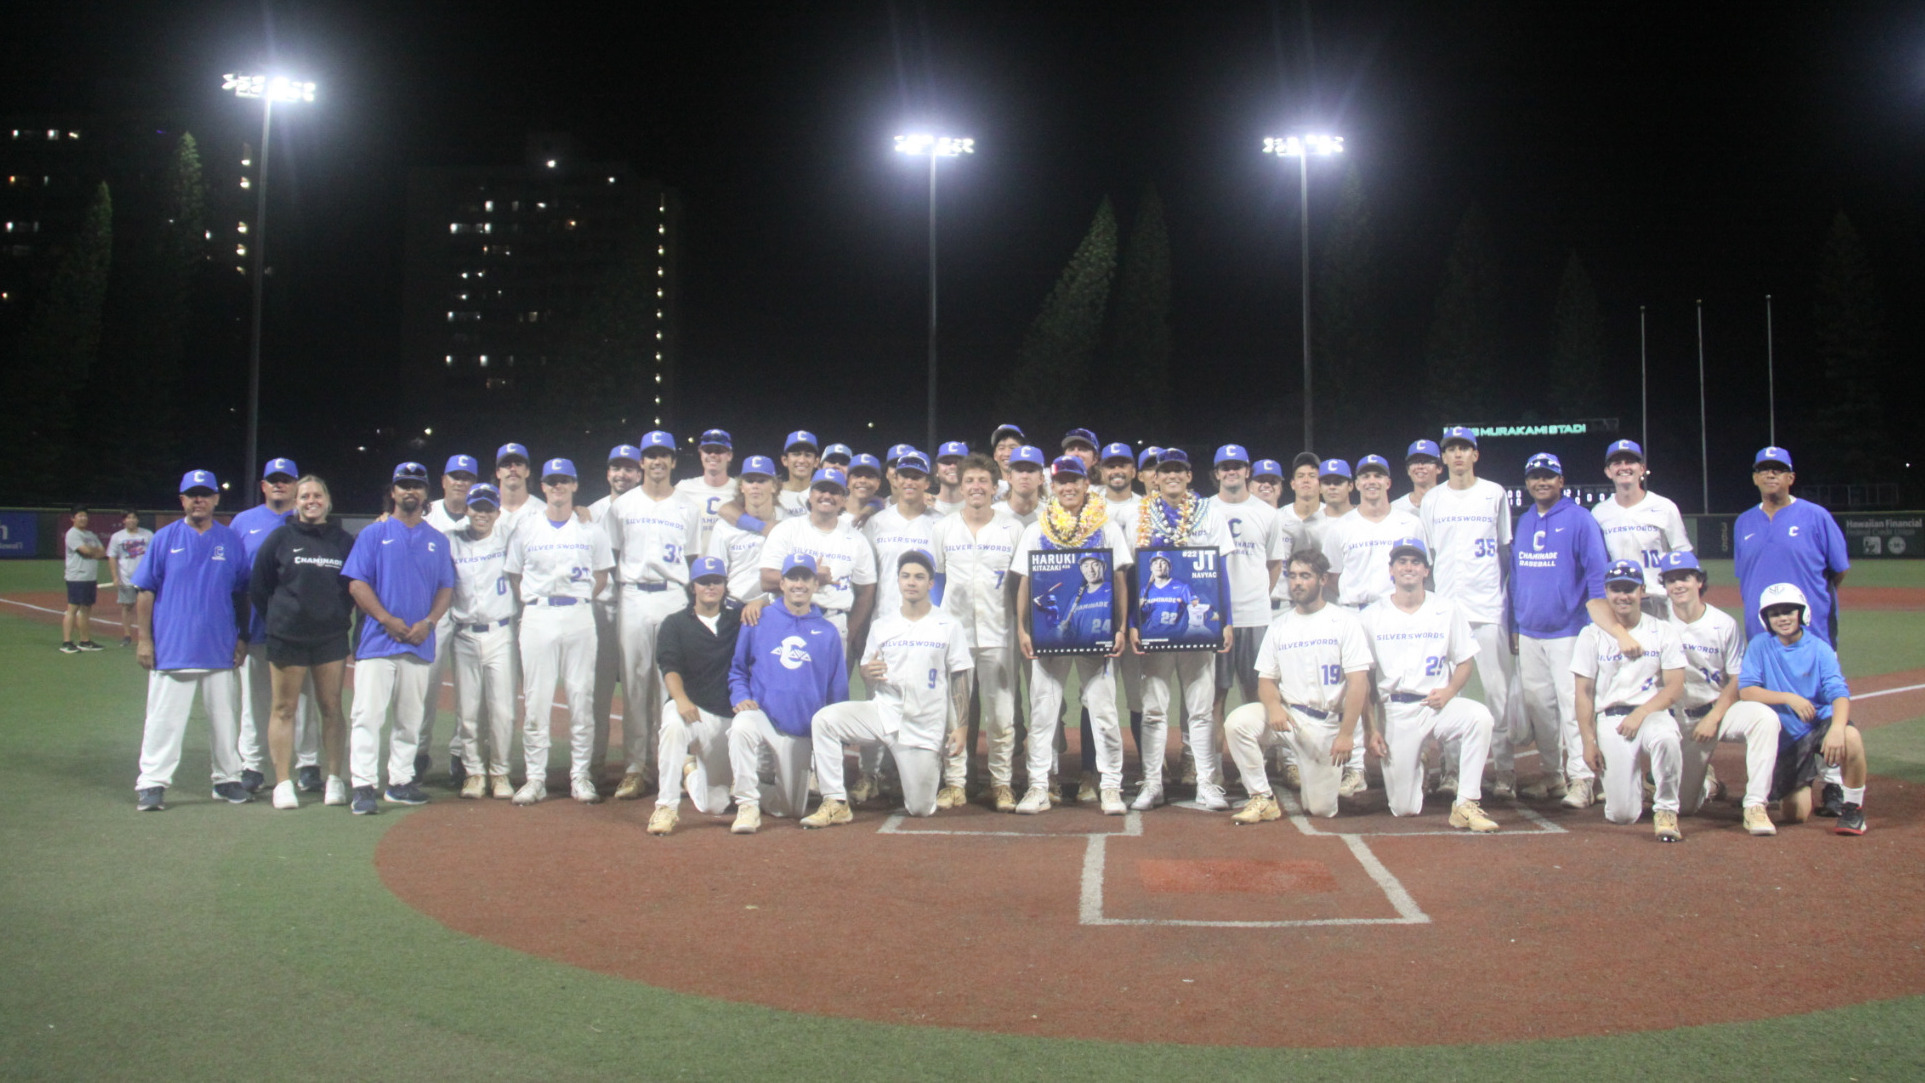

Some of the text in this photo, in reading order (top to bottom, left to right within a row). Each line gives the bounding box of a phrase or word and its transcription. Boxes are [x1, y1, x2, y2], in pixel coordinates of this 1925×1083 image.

[797, 430, 808, 441] C
[1452, 426, 1463, 436] C
[1480, 426, 1547, 437] MURAKAMI
[652, 432, 662, 444] C
[506, 442, 518, 452] C
[834, 444, 844, 453] C
[948, 443, 959, 452] C
[1110, 444, 1121, 454] C
[1416, 440, 1427, 450] C
[1618, 440, 1630, 450] C
[620, 446, 631, 456] C
[1020, 446, 1032, 458] C
[1226, 446, 1237, 456] C
[1765, 446, 1777, 458] C
[274, 458, 286, 469] C
[458, 456, 469, 466] C
[752, 456, 762, 468] C
[860, 454, 872, 464] C
[1367, 454, 1378, 464] C
[551, 460, 562, 470] C
[1264, 460, 1274, 470] C
[1327, 460, 1338, 472] C
[194, 471, 205, 482] C
[824, 468, 836, 480] C
[1846, 518, 1922, 528] Hawaiian Financial
[1788, 526, 1799, 536] C
[1533, 530, 1546, 550] C
[794, 552, 806, 564] C
[1032, 554, 1076, 565] HARUKI
[1518, 550, 1558, 560] CHAMINADE
[1669, 552, 1682, 565] C
[704, 558, 717, 570] C
[1193, 550, 1217, 572] JT
[1519, 560, 1556, 568] BASEBALL
[994, 570, 1006, 590] 7
[496, 576, 506, 596] 0
[1322, 664, 1341, 686] 19
